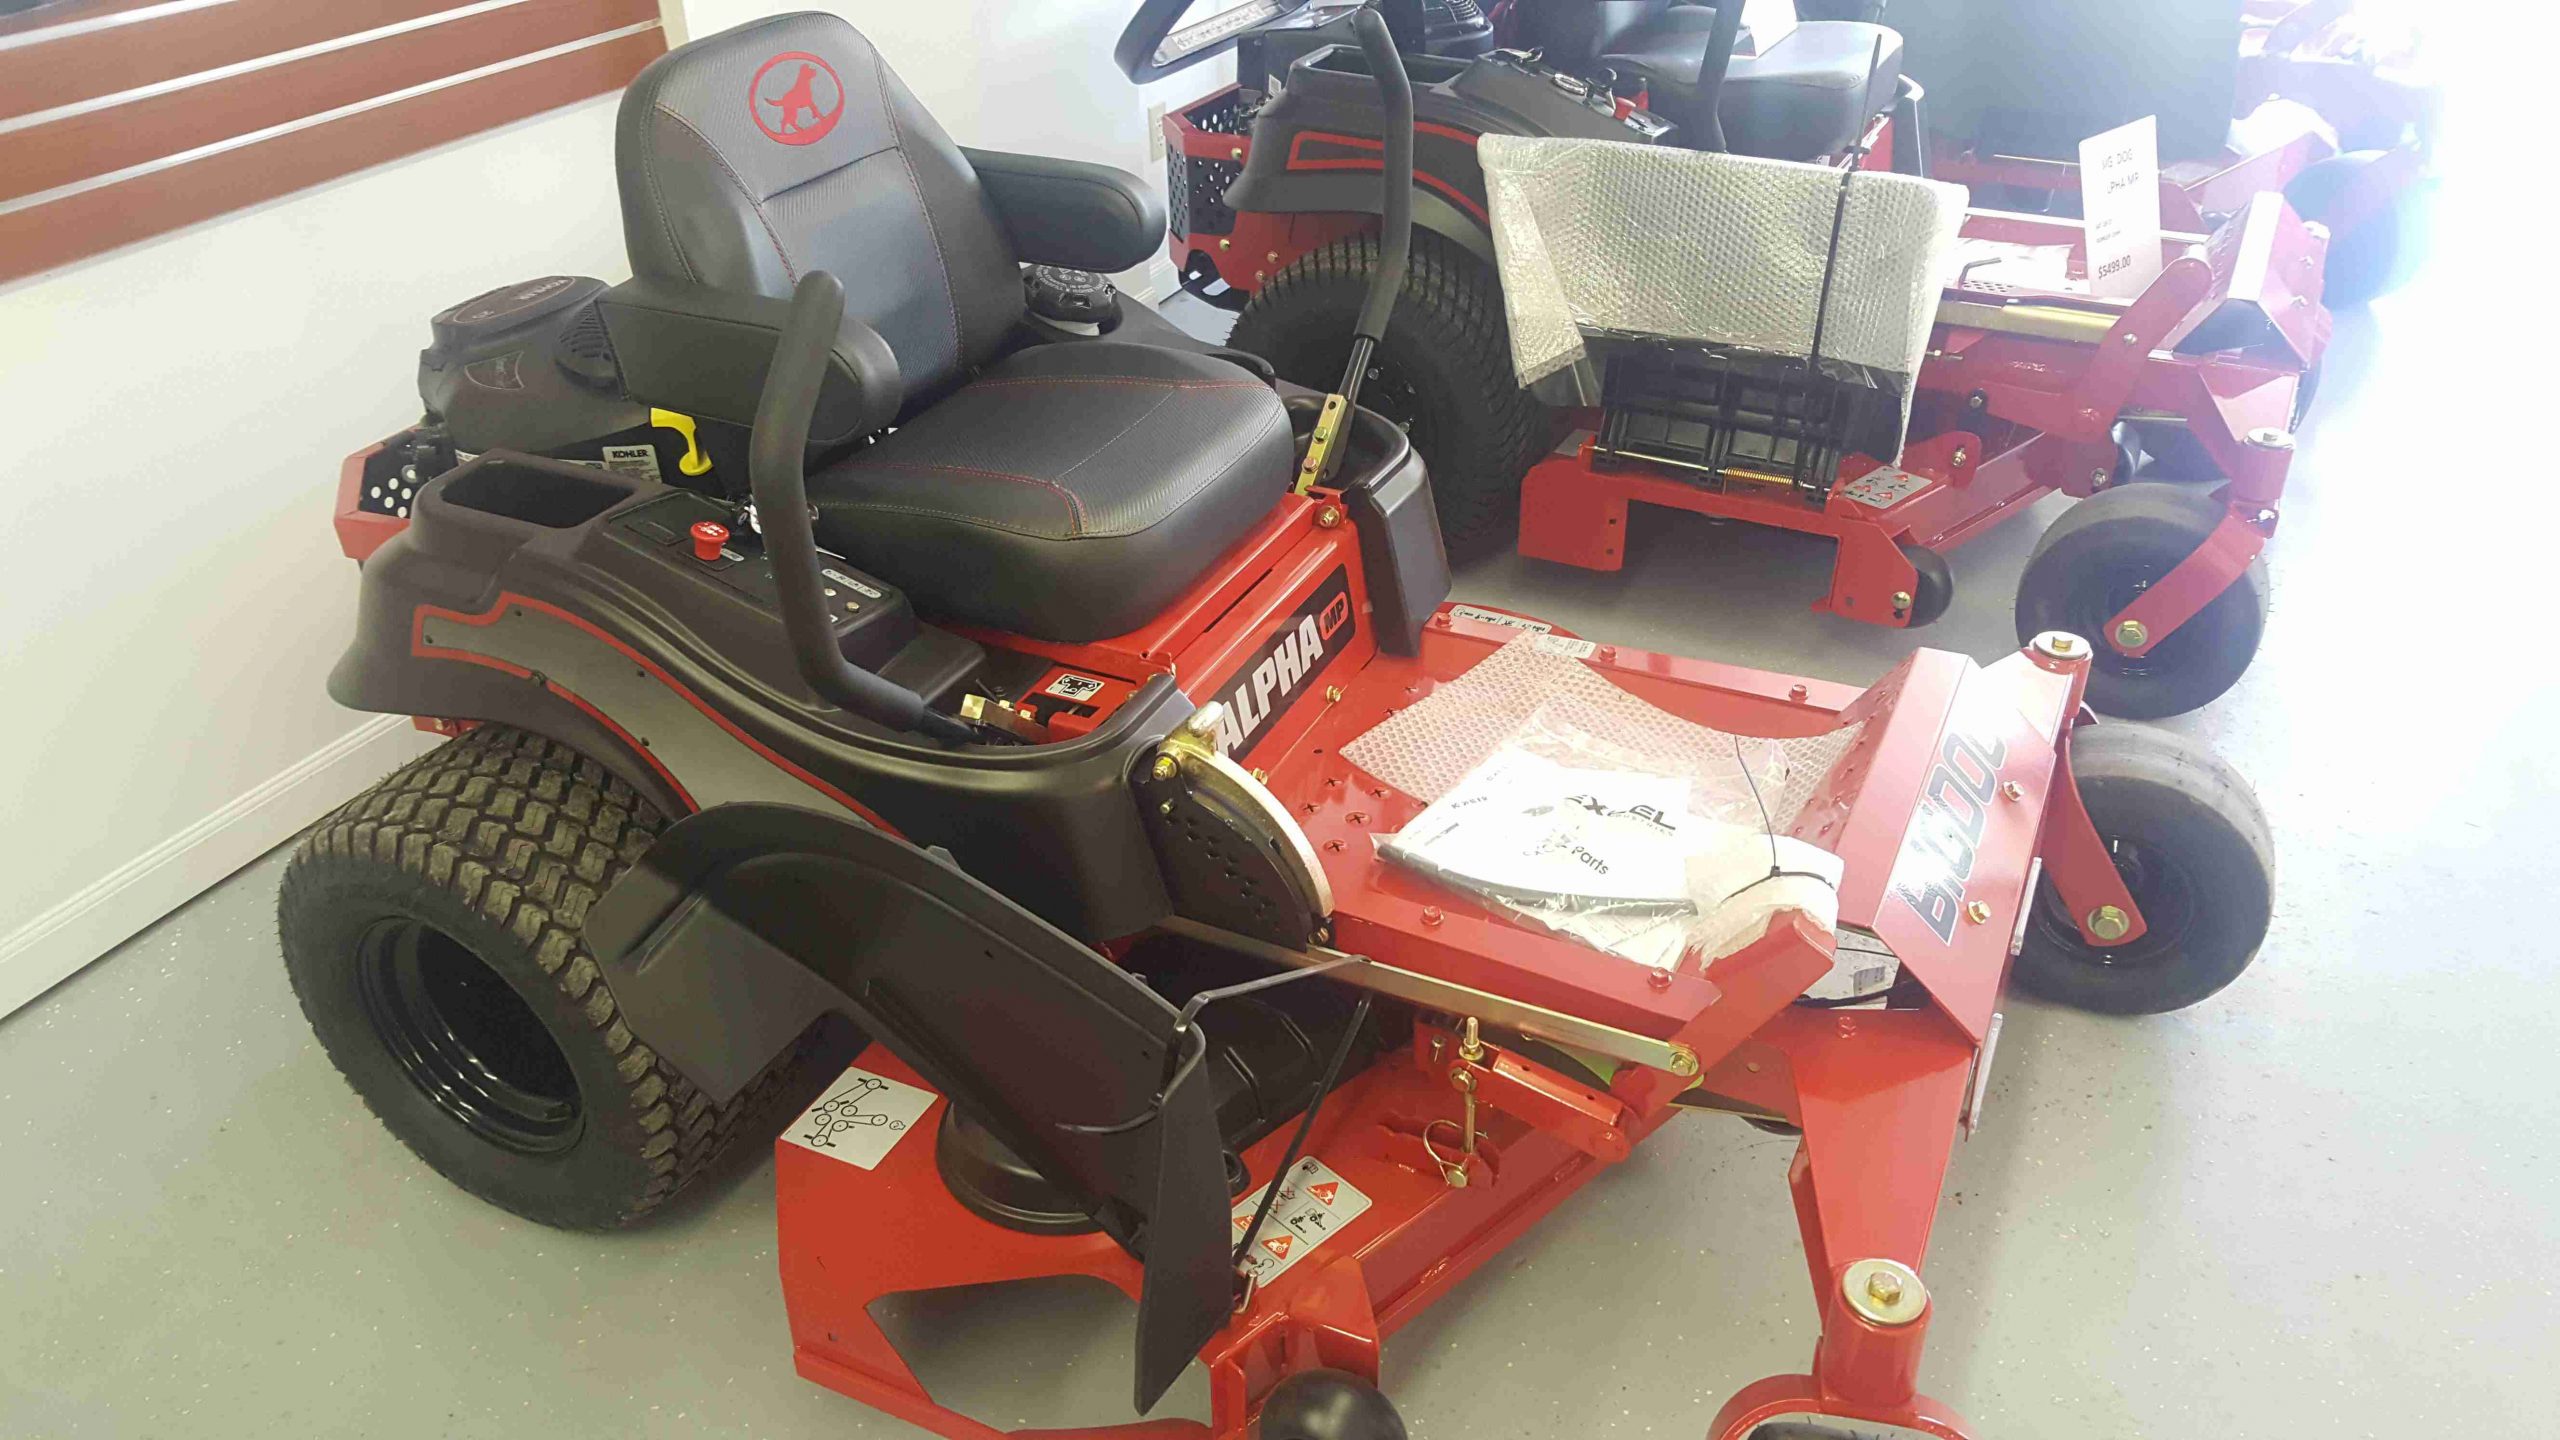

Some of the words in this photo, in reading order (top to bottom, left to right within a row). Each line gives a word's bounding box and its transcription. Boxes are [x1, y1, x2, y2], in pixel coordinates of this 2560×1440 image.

[2098, 255, 2131, 280] $5499.00
[611, 449, 648, 459] KOHLER
[1216, 614, 1324, 758] ALPHA
[1324, 598, 1345, 635] MP
[1571, 845, 1609, 875] Parts
